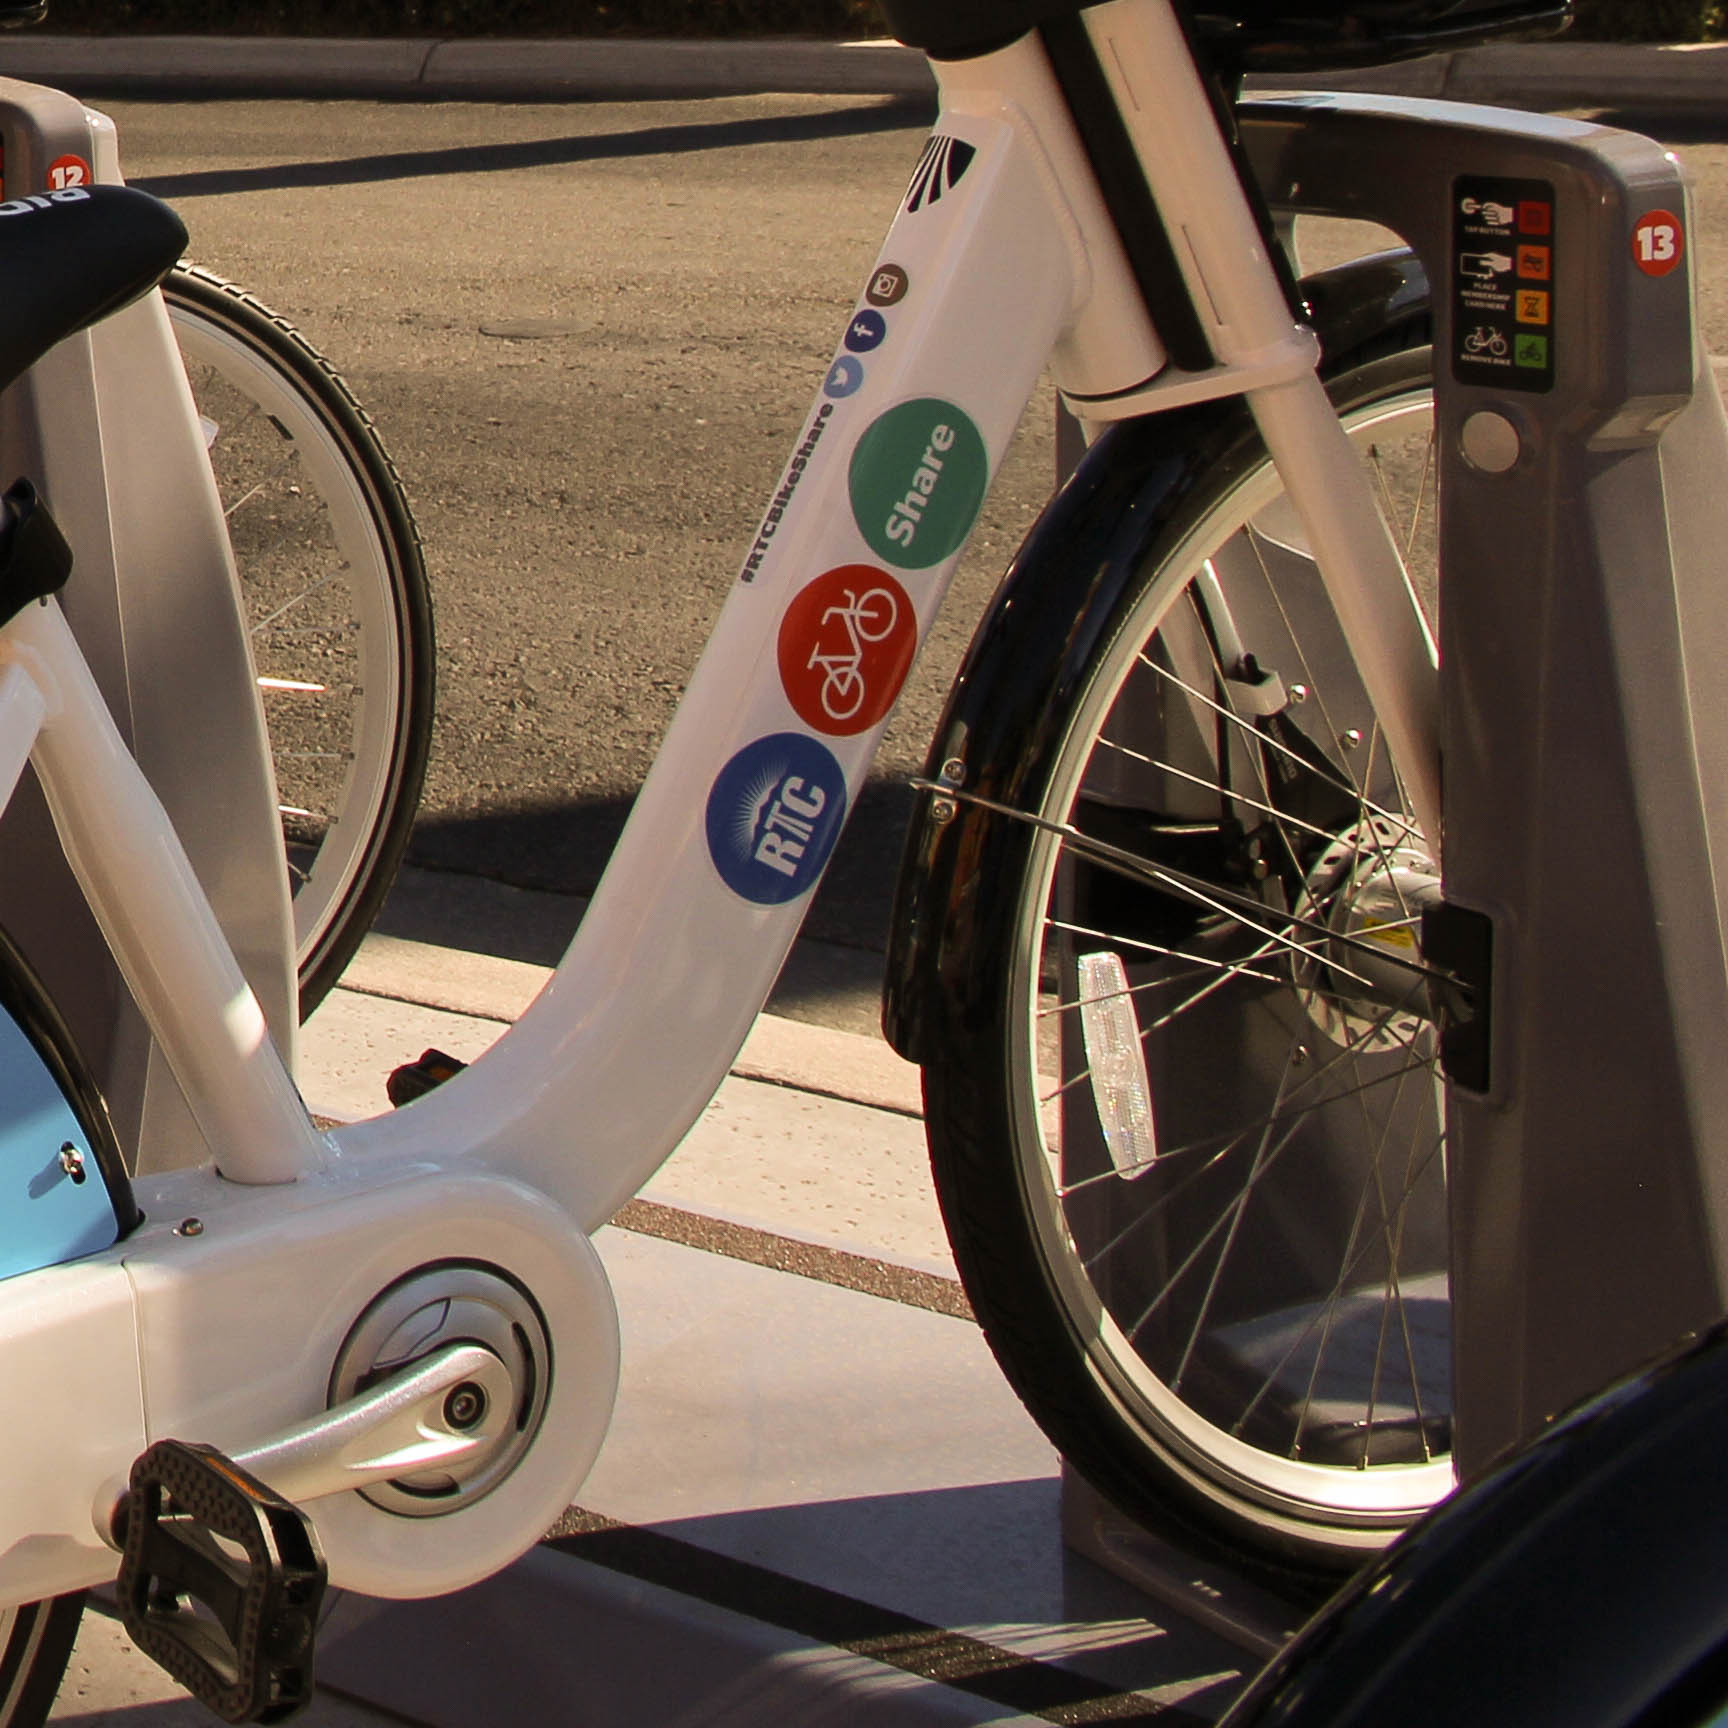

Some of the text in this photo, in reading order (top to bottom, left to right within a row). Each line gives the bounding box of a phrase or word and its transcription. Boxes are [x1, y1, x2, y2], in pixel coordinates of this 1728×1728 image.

[51, 165, 84, 190] 12
[1637, 224, 1675, 261] 13
[740, 400, 834, 585] #RTCBikeShare
[885, 423, 956, 548] Share
[754, 773, 826, 878] RTC
